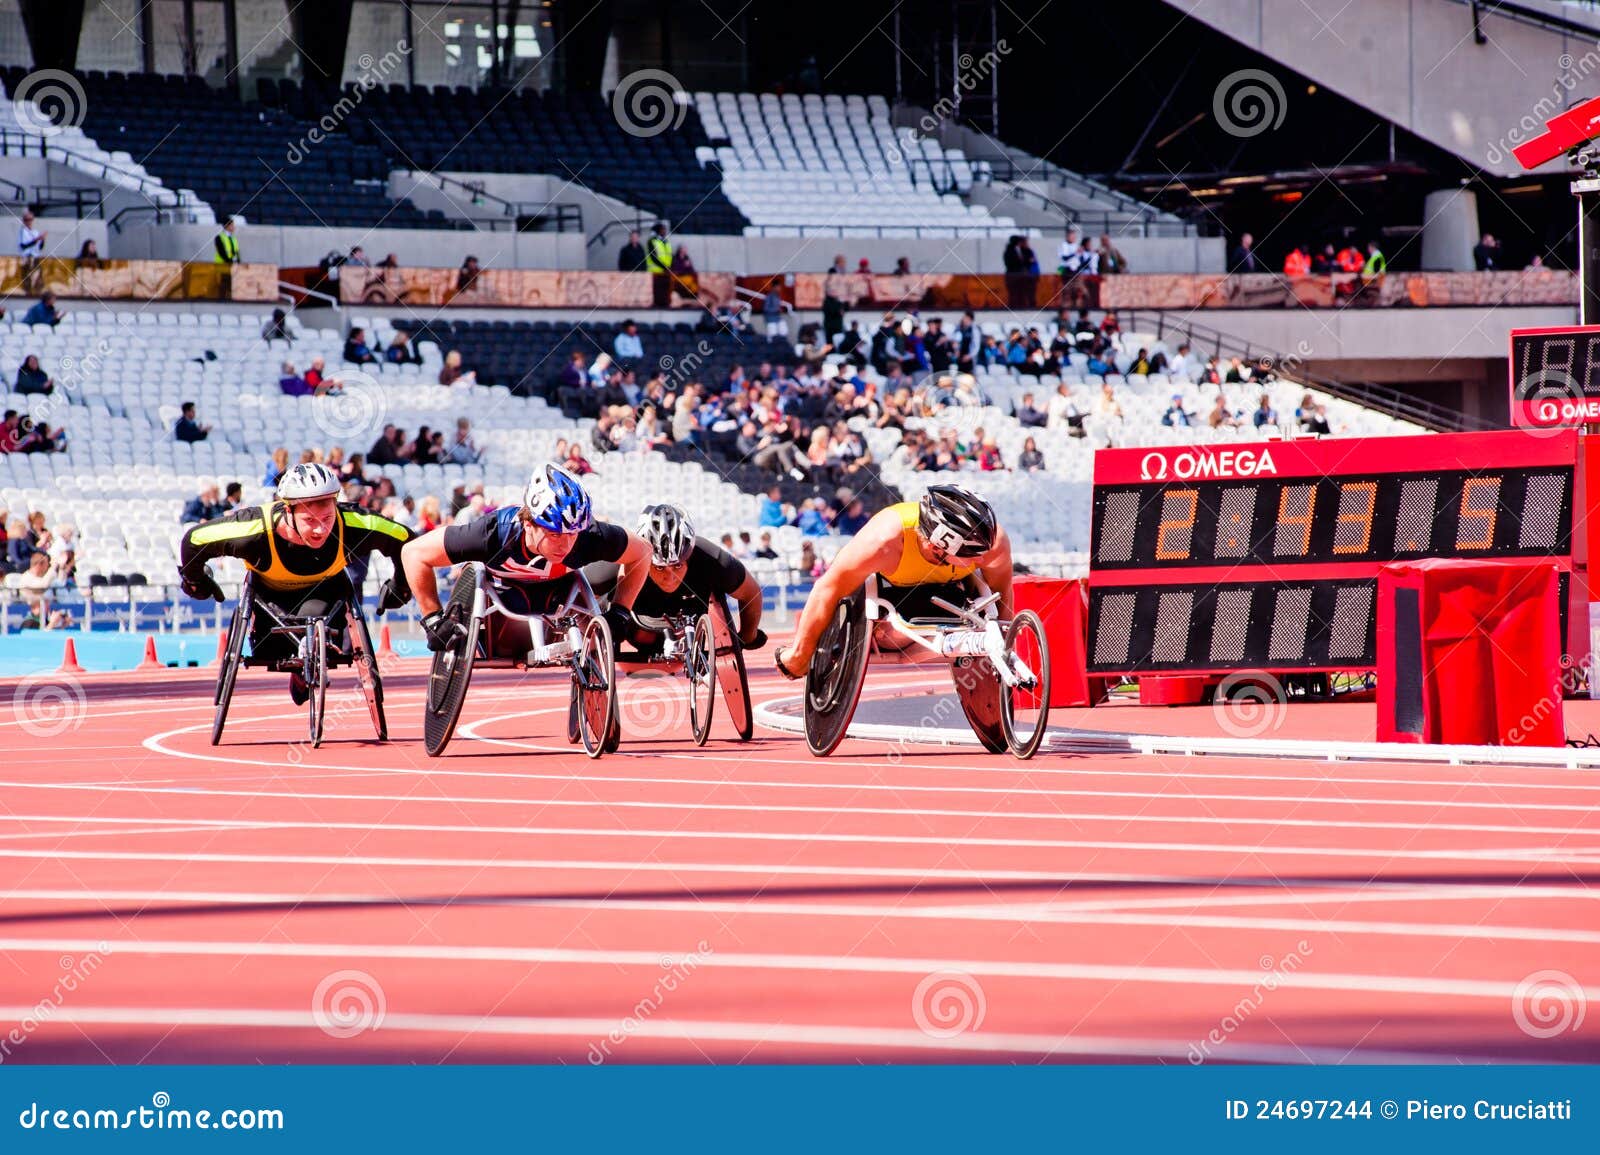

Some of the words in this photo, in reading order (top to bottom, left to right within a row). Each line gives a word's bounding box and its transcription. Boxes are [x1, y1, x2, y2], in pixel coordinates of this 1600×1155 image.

[1561, 401, 1600, 418] OME
[1174, 449, 1277, 478] OMEGA
[937, 532, 955, 550] 5
